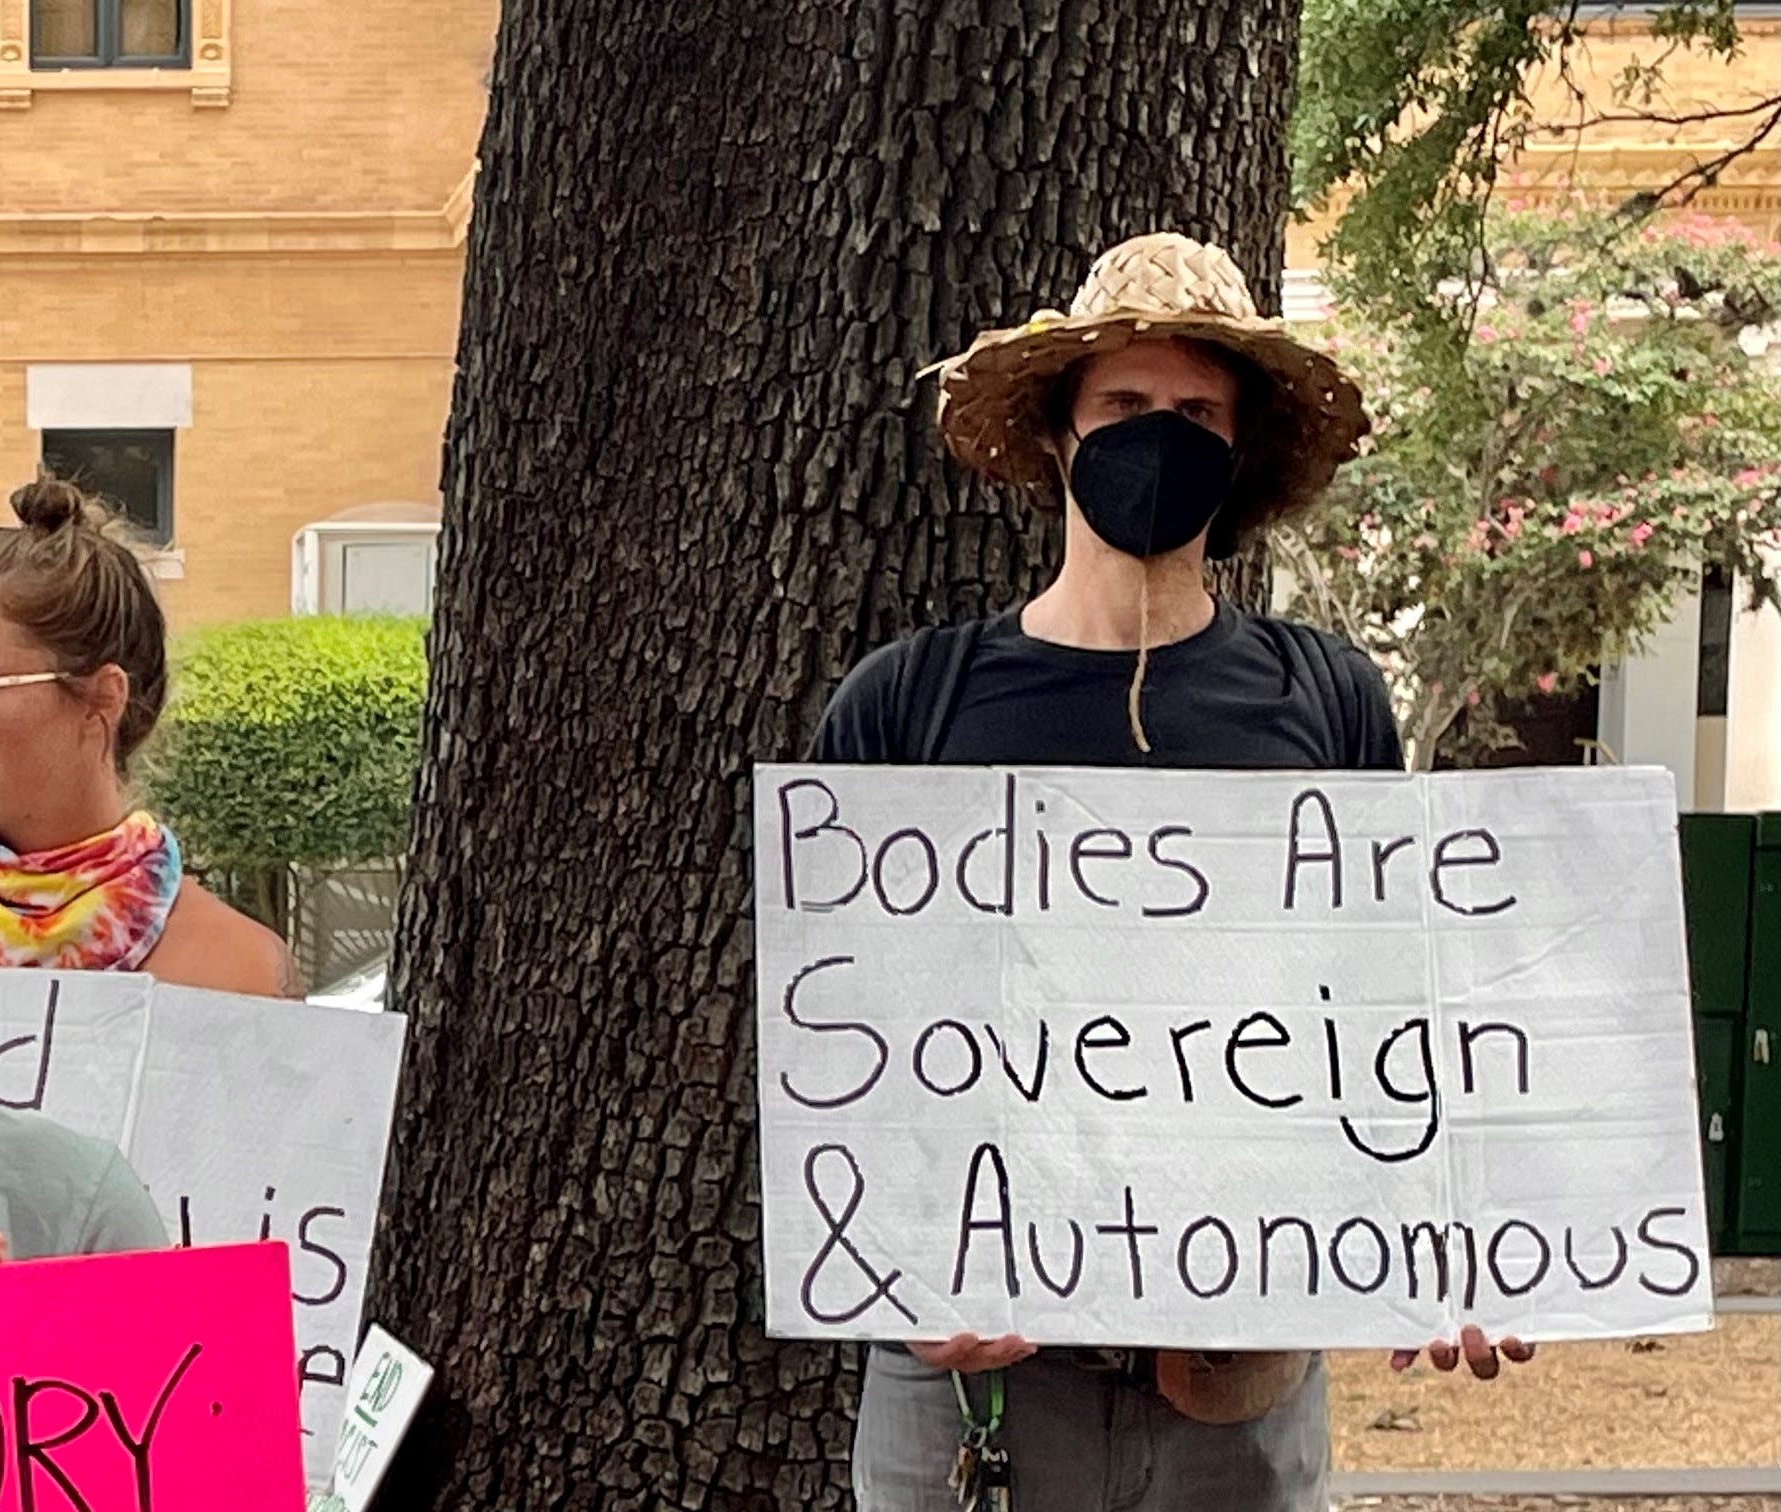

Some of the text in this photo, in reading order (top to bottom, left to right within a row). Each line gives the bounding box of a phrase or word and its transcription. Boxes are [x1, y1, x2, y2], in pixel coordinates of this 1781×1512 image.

[777, 772, 1517, 916] Bodies Are
[780, 955, 1531, 1162] Sovereign
[800, 1141, 1700, 1326] & Autonomous
